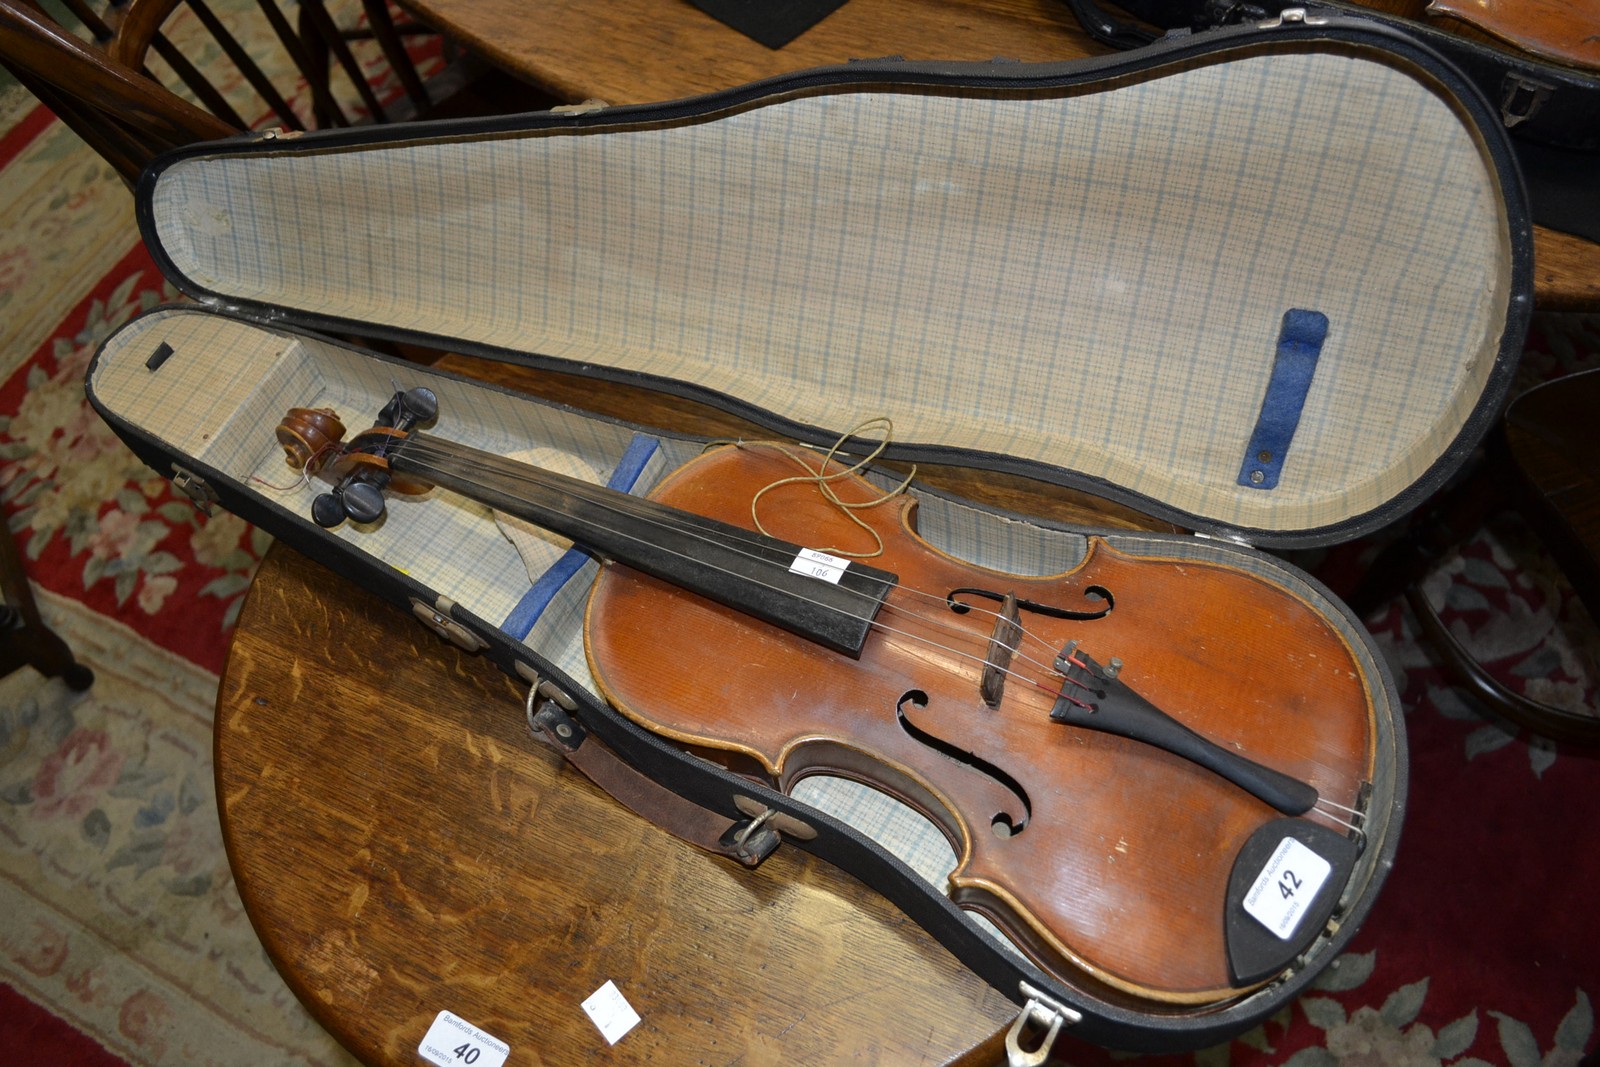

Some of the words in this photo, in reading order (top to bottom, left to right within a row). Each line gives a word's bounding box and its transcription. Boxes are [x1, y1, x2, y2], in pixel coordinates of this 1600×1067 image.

[811, 566, 829, 577] 106
[1248, 877, 1269, 906] Bamfords
[1266, 837, 1295, 877] Auctioneers
[1278, 870, 1302, 900] 42
[443, 1014, 473, 1035] Bamfords
[473, 1031, 509, 1056] Auctioneers
[425, 1045, 452, 1064] 16/09/2015
[453, 1042, 480, 1065] 40
